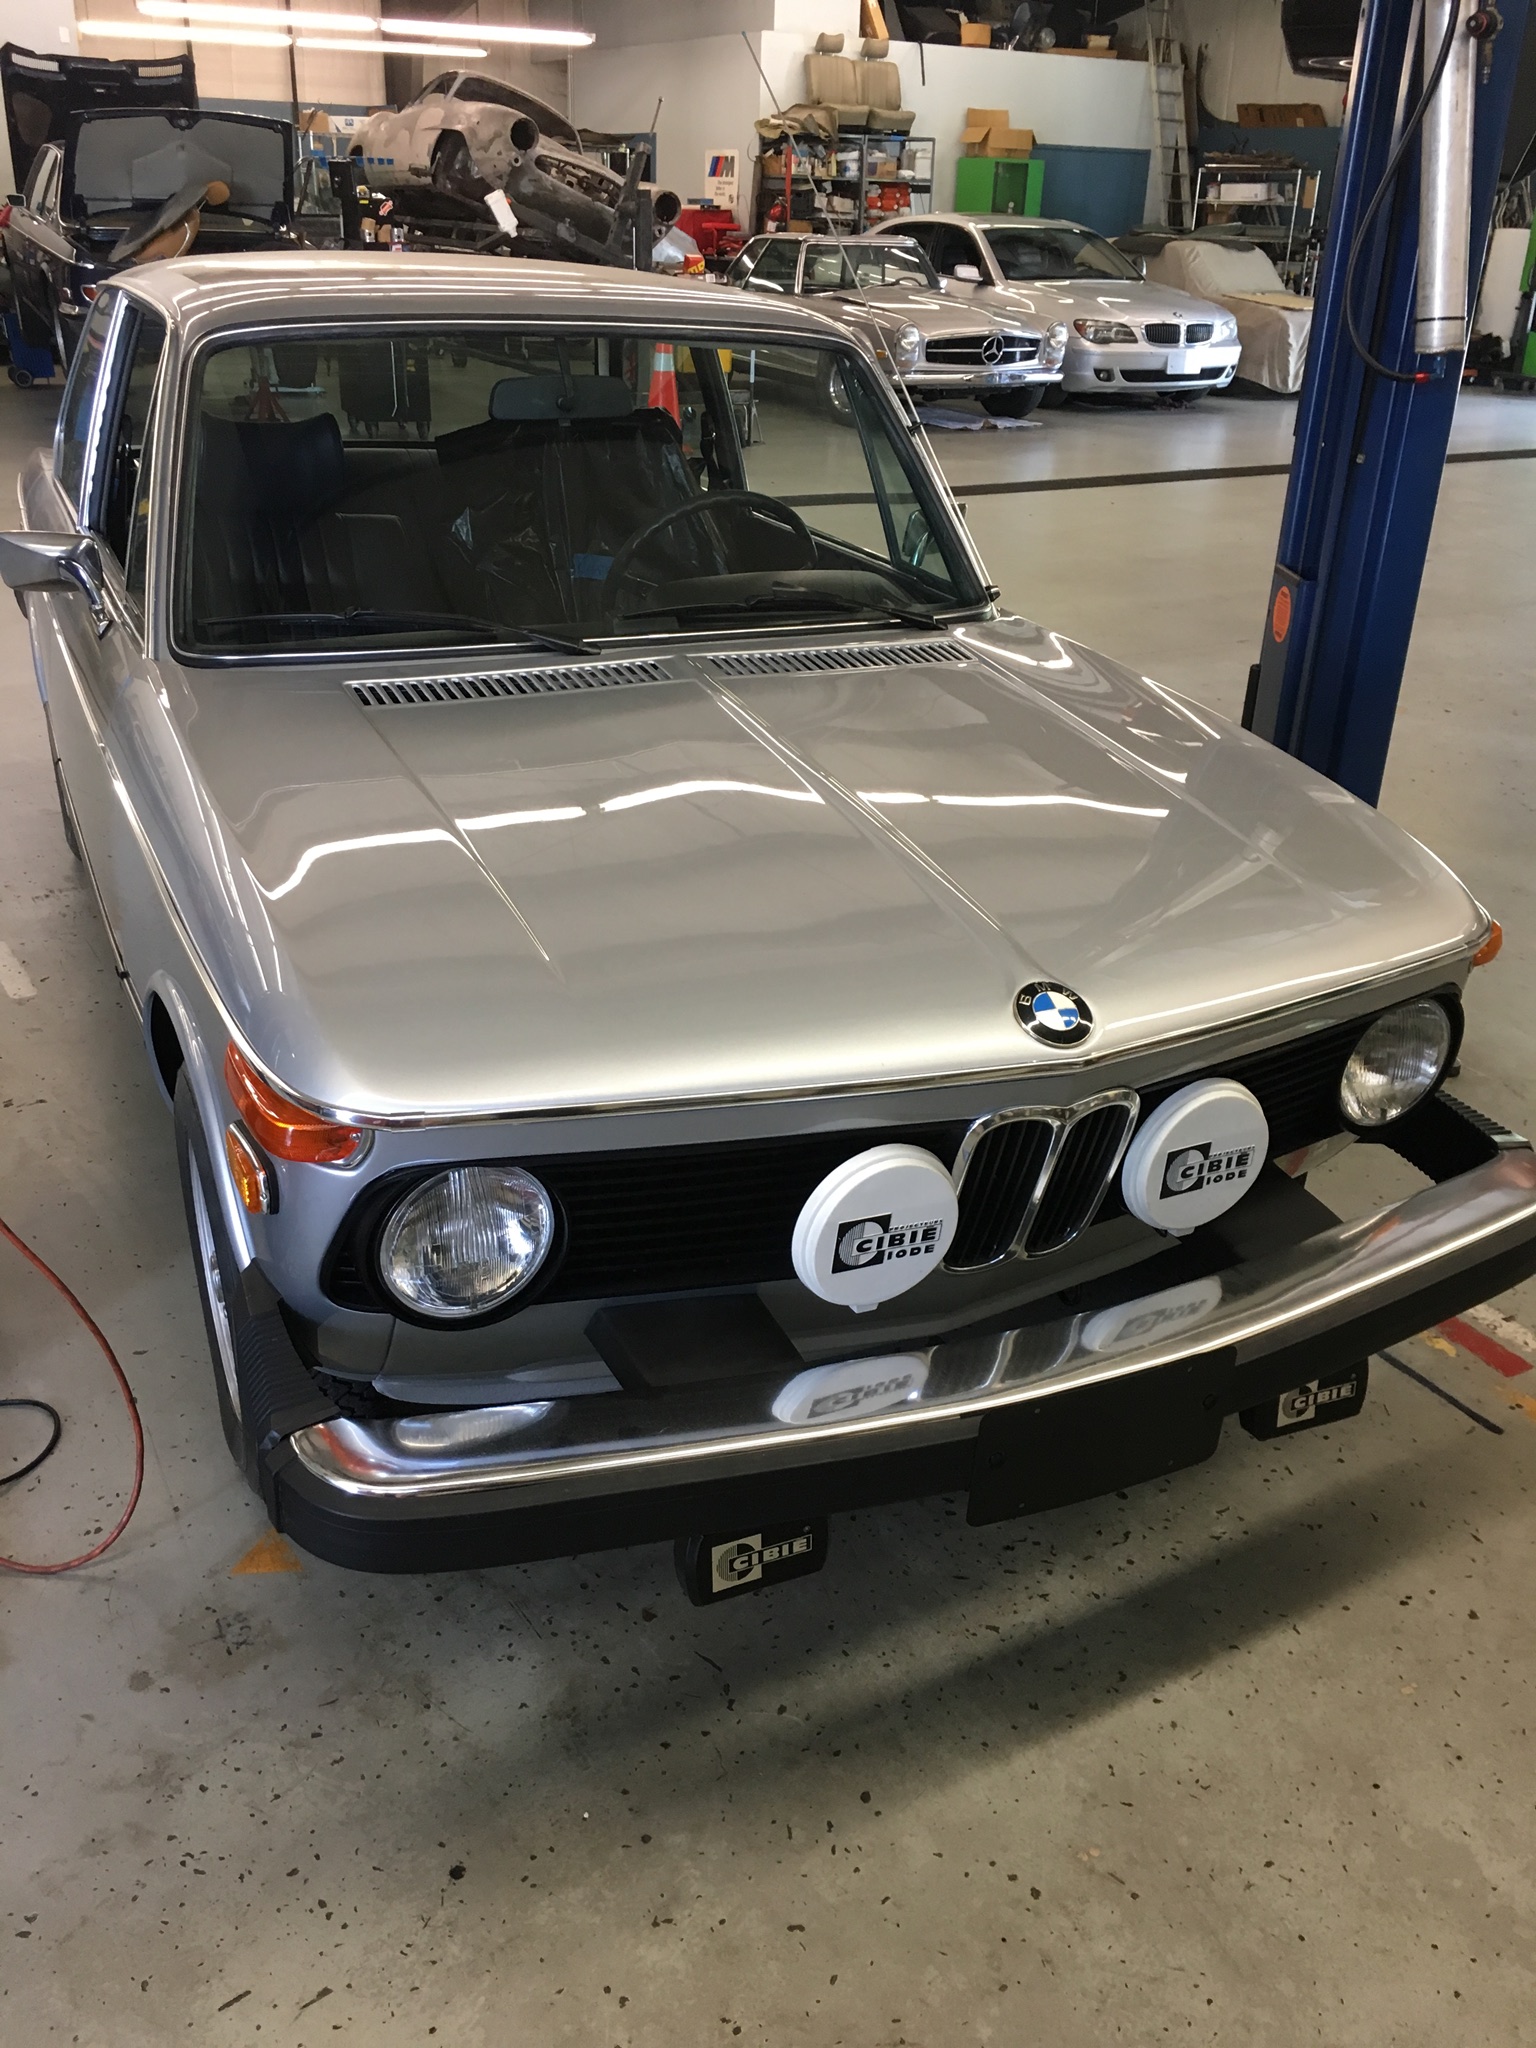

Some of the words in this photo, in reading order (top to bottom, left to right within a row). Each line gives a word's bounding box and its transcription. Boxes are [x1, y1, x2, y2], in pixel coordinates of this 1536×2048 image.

[1019, 982, 1079, 1006] BMW
[1206, 1169, 1248, 1186] IODE
[887, 1244, 935, 1261] IODE
